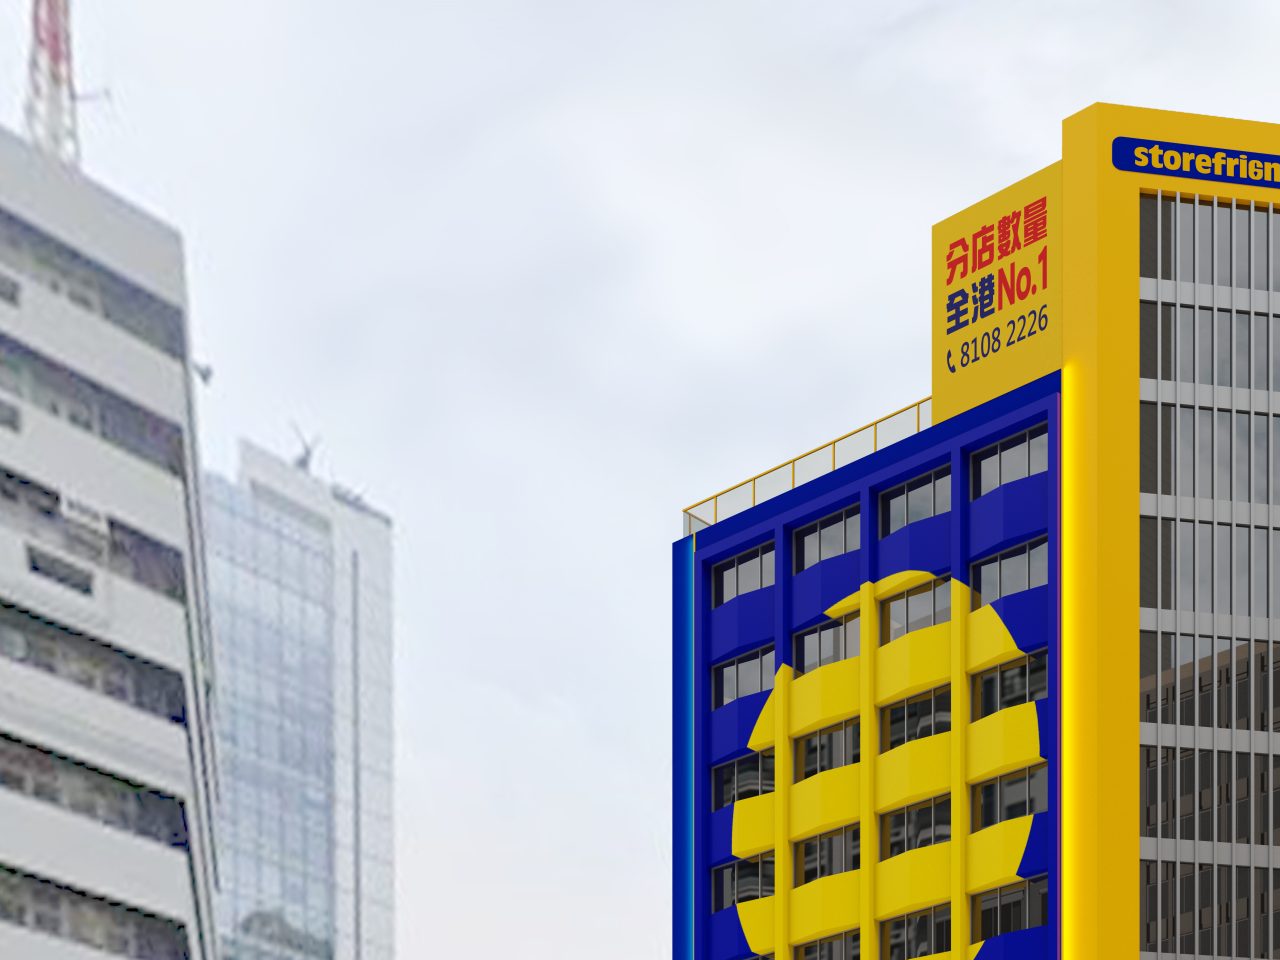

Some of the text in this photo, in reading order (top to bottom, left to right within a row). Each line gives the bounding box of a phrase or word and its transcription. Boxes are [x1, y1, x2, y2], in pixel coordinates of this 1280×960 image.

[946, 196, 1047, 286] 分店數量
[960, 304, 1048, 368] 8108 2226
